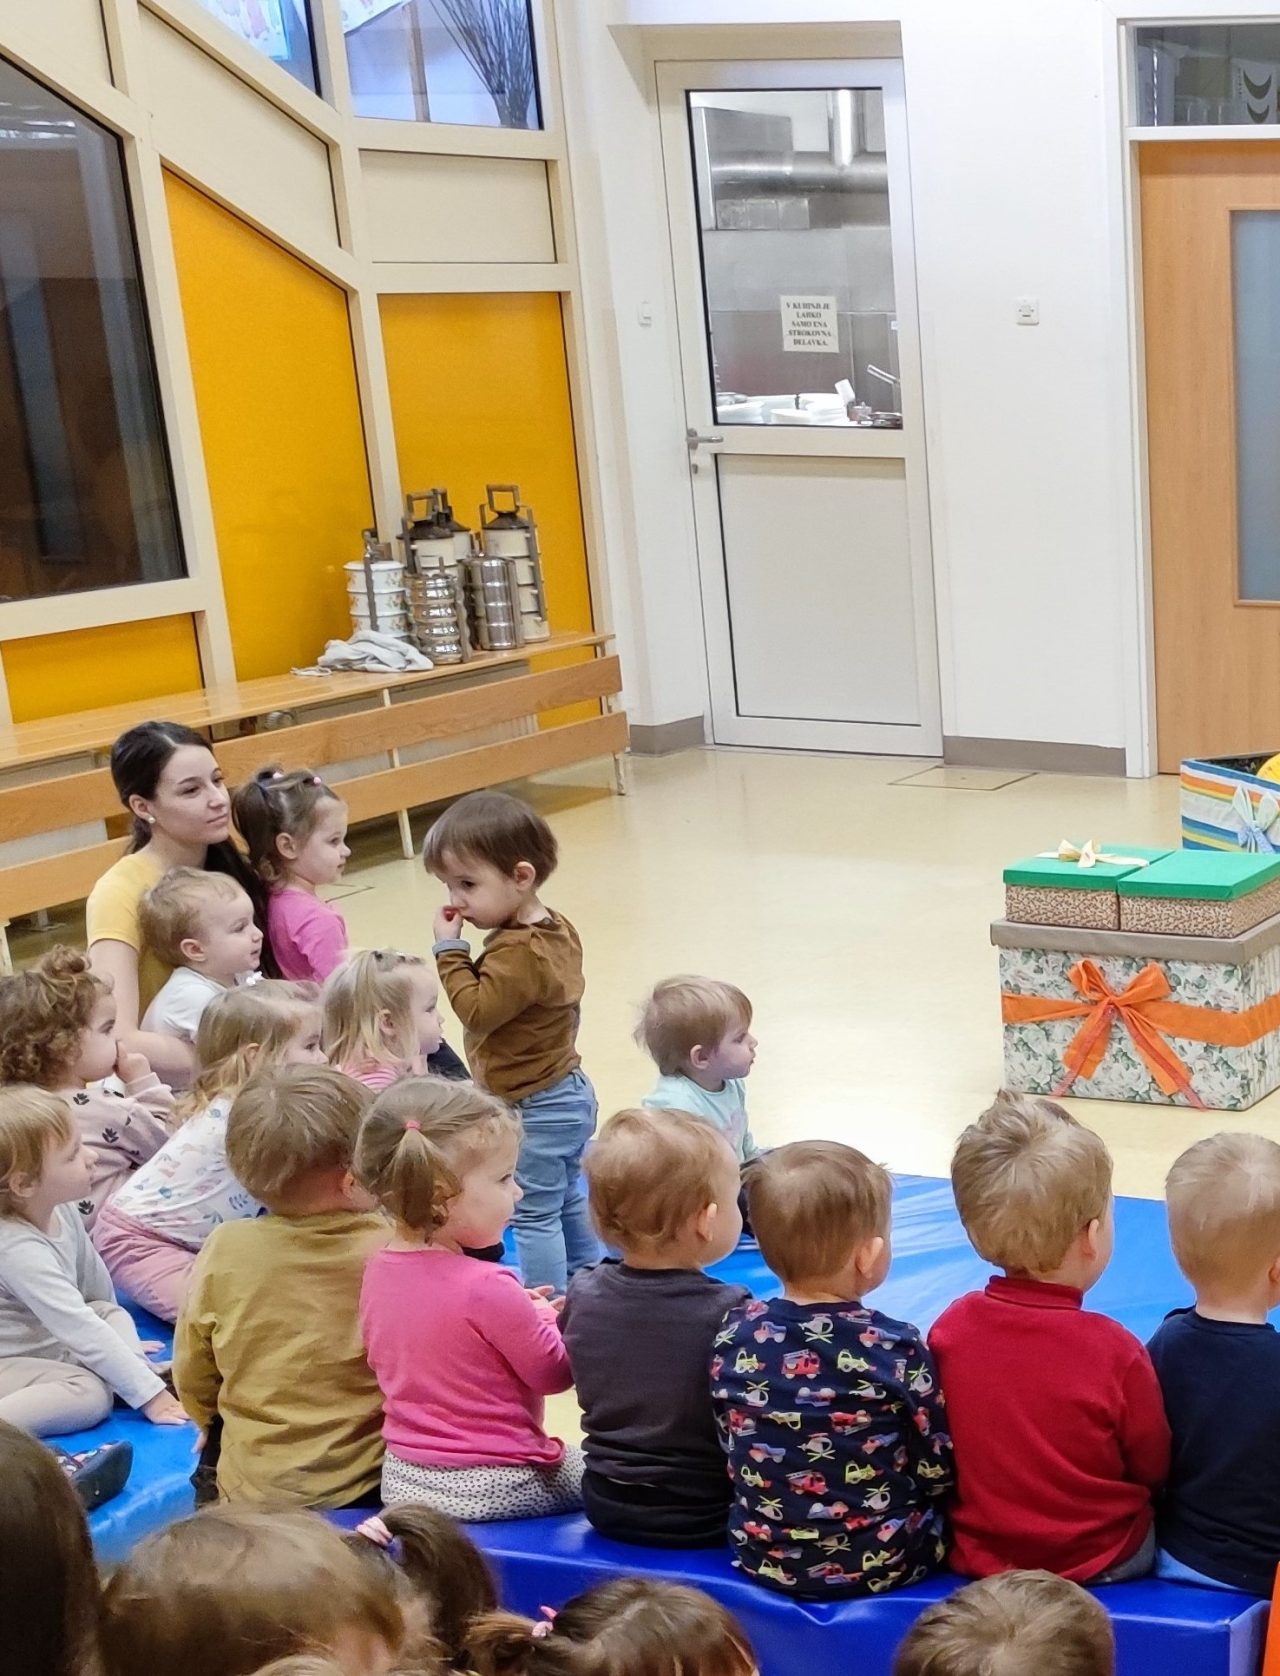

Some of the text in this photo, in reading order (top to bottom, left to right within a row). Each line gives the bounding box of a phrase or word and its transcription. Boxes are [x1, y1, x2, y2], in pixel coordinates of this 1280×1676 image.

[791, 320, 828, 328] SAMO ENA
[788, 329, 832, 337] STROKOVNA
